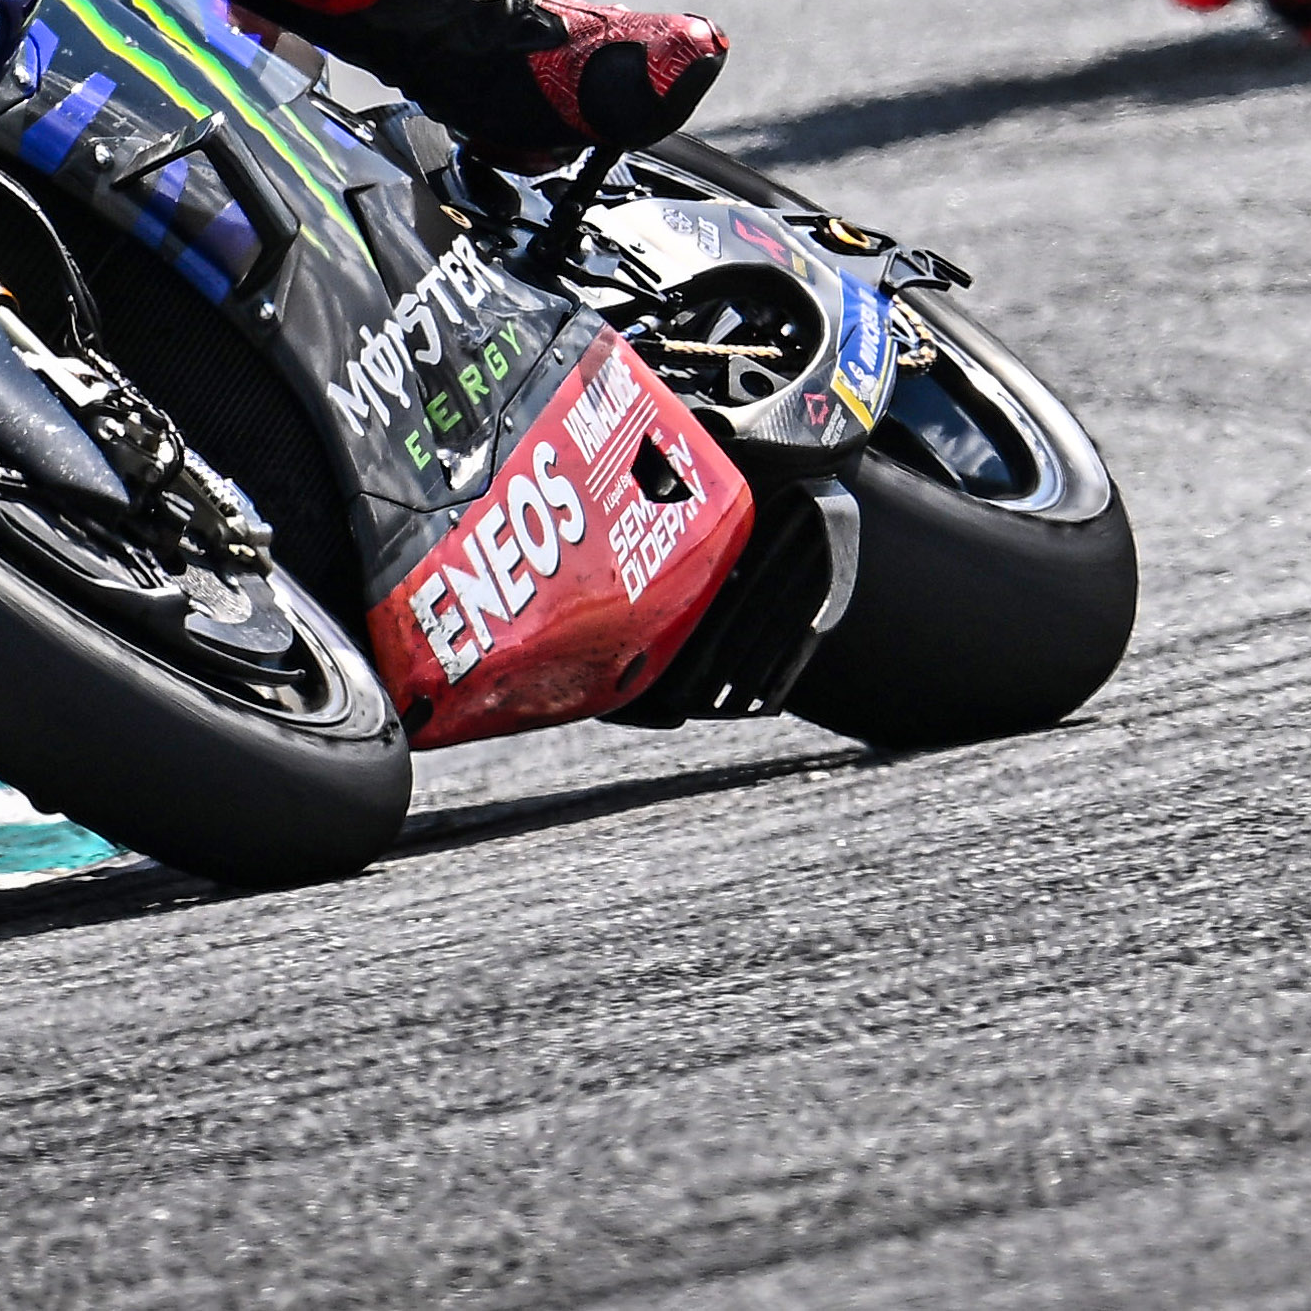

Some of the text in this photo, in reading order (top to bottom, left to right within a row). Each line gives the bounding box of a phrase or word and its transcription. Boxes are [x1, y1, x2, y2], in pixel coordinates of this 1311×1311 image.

[404, 320, 522, 471] EERGY
[562, 346, 641, 465] YAMALUBE
[409, 440, 586, 685] ENEOS
